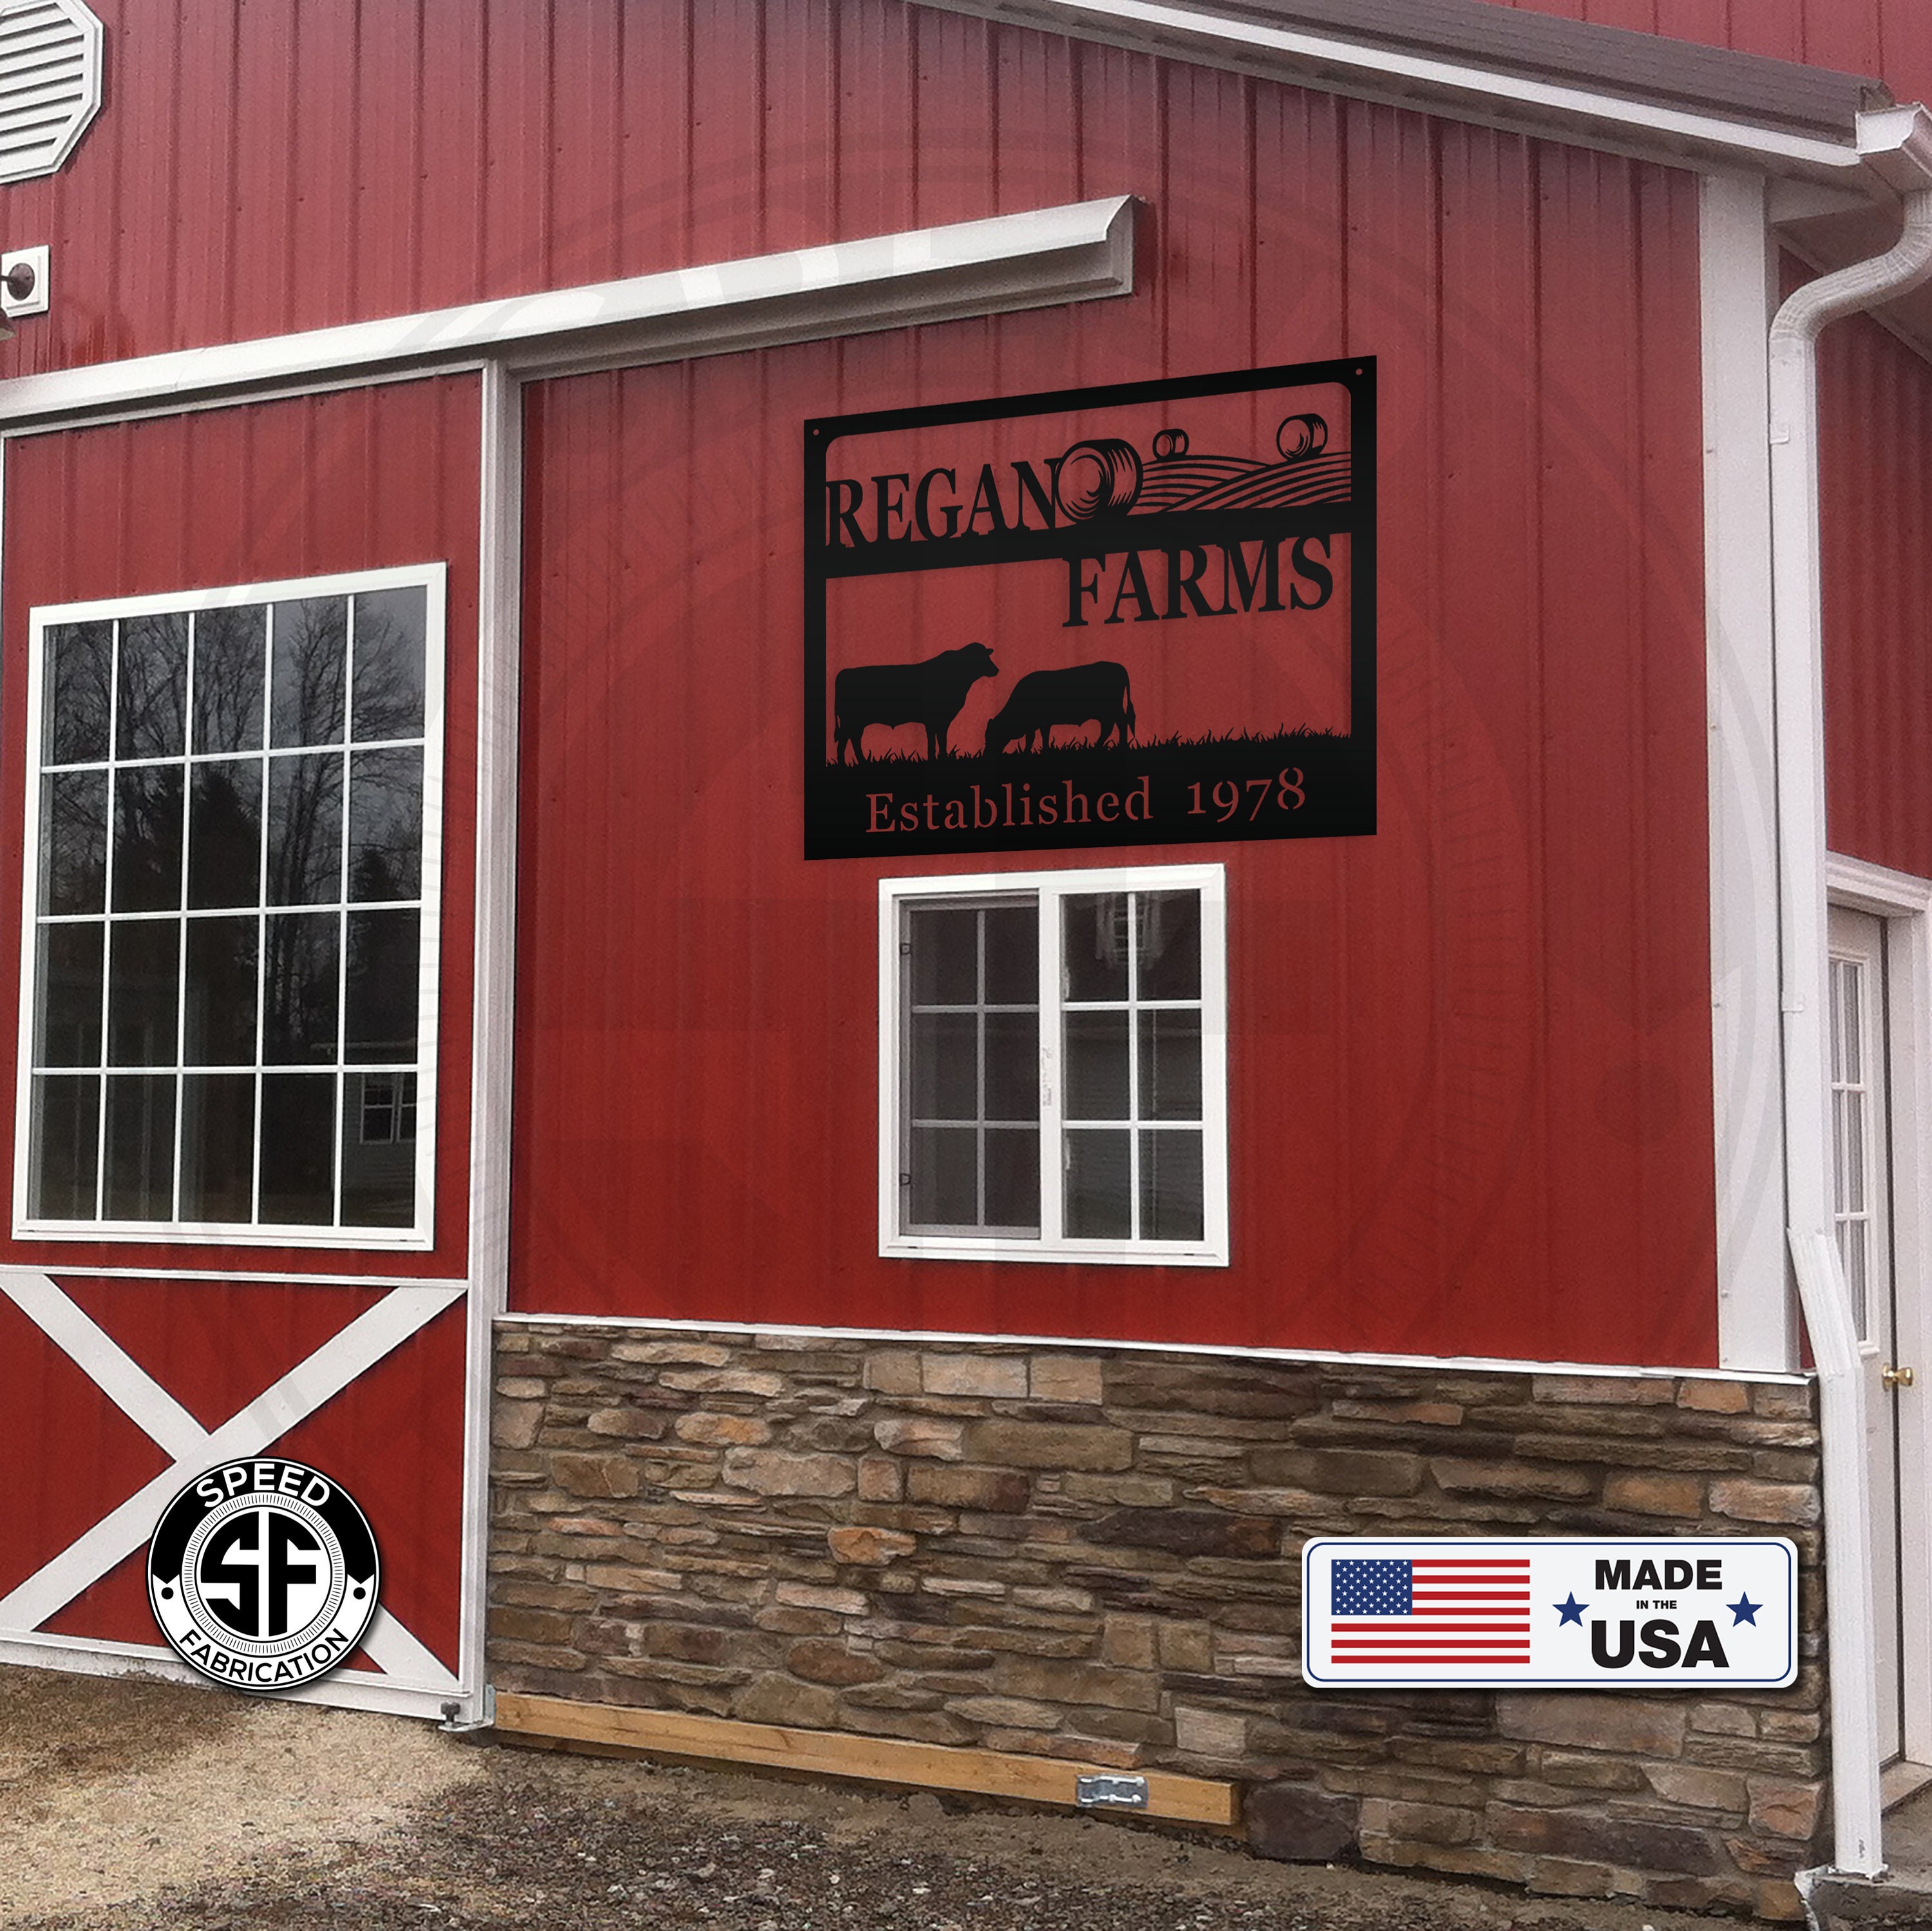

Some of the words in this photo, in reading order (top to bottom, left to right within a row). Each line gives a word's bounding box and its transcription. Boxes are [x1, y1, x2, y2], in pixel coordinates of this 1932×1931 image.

[826, 457, 1064, 549] REGAN
[1062, 535, 1334, 627] FARMS
[866, 775, 1153, 833] Established
[1188, 767, 1306, 823] 1978
